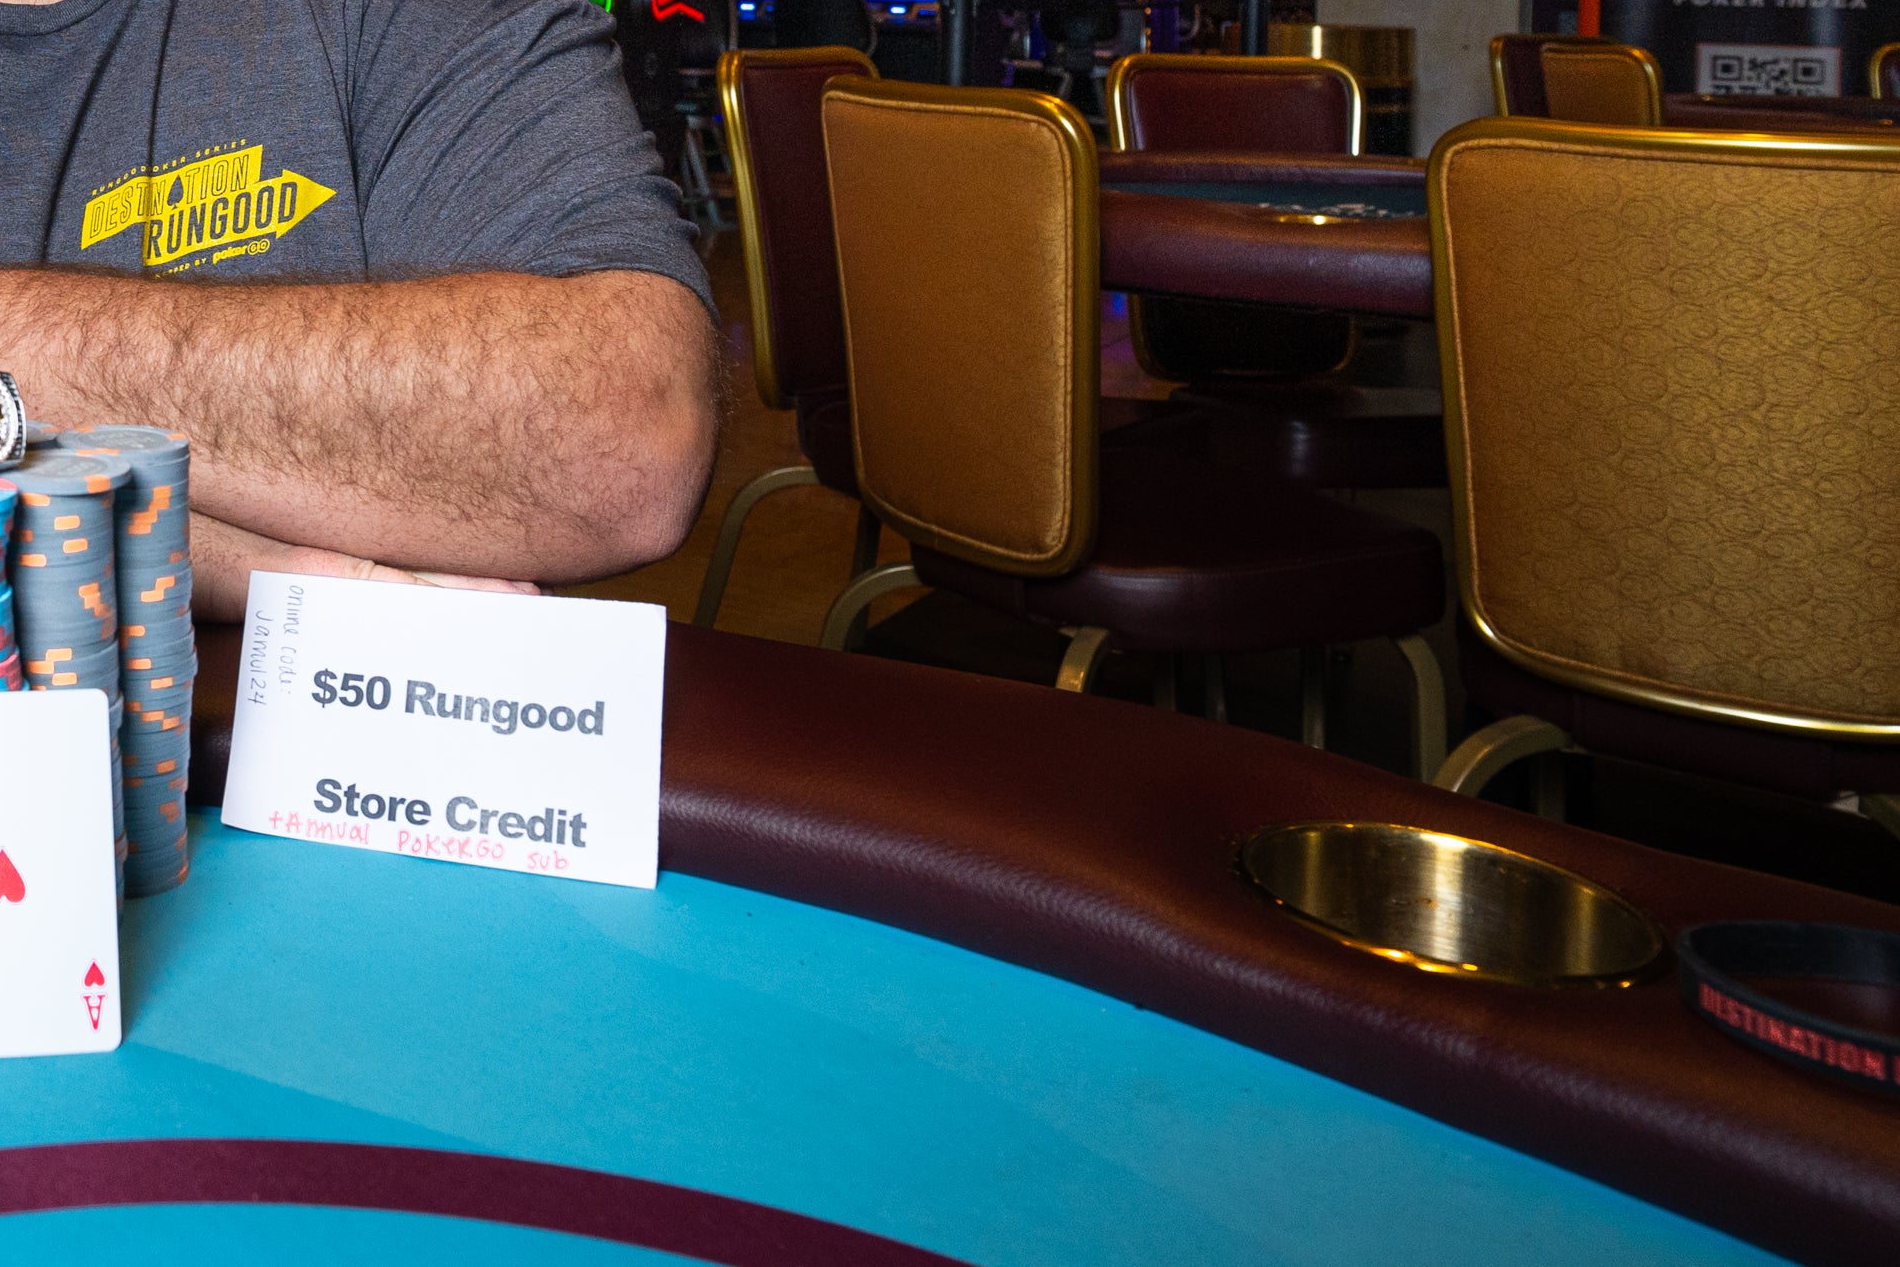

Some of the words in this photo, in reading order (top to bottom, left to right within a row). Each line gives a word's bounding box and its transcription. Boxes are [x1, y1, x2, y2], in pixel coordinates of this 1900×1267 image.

[148, 156, 186, 174] OKER
[196, 139, 247, 159] SERIES
[146, 181, 299, 260] RUNGOOD
[311, 668, 391, 710] $50
[405, 679, 605, 736] Rungood
[313, 778, 432, 826] Store
[445, 796, 587, 848] Credit
[83, 995, 106, 1031] A
